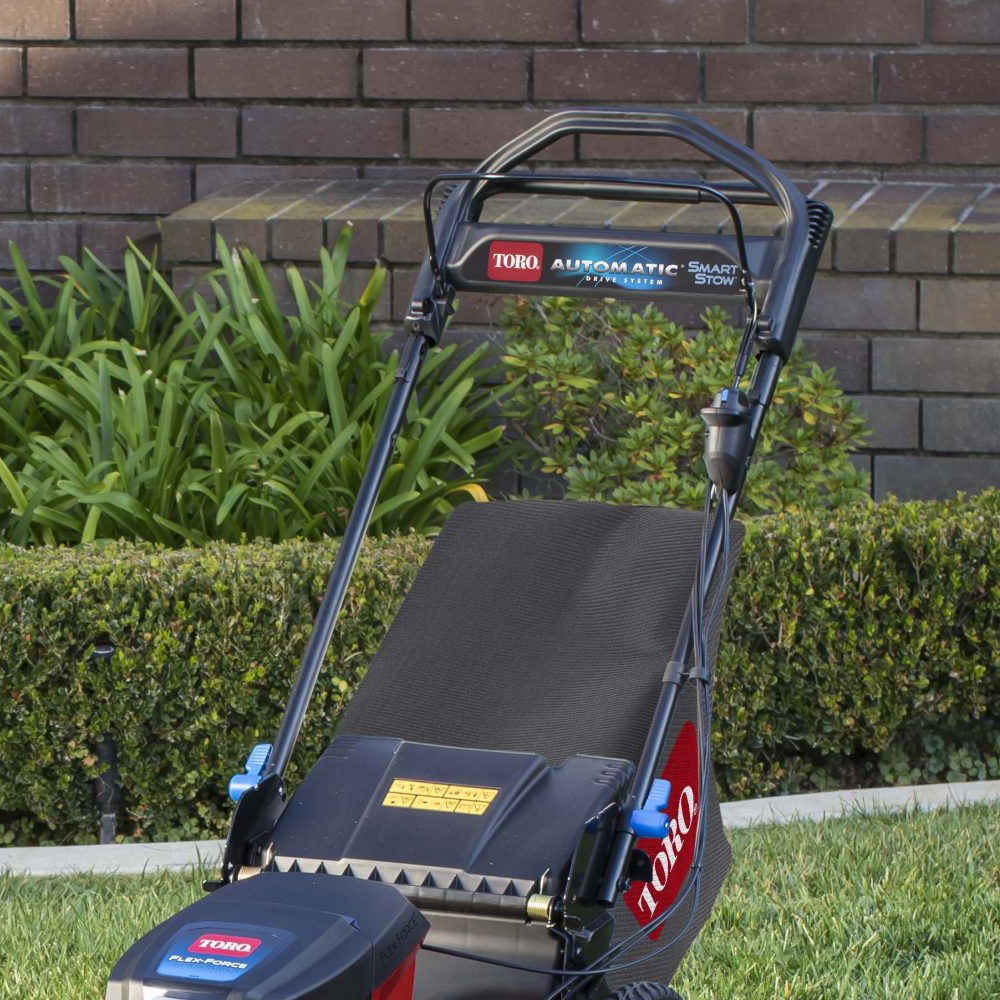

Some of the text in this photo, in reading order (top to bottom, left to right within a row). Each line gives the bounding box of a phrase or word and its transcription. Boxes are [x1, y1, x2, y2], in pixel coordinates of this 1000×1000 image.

[493, 253, 679, 277] TORO AUTOMATIC
[688, 261, 738, 274] SMART
[586, 275, 617, 283] DRIVE
[695, 273, 735, 286] STOW
[199, 939, 251, 952] TORO
